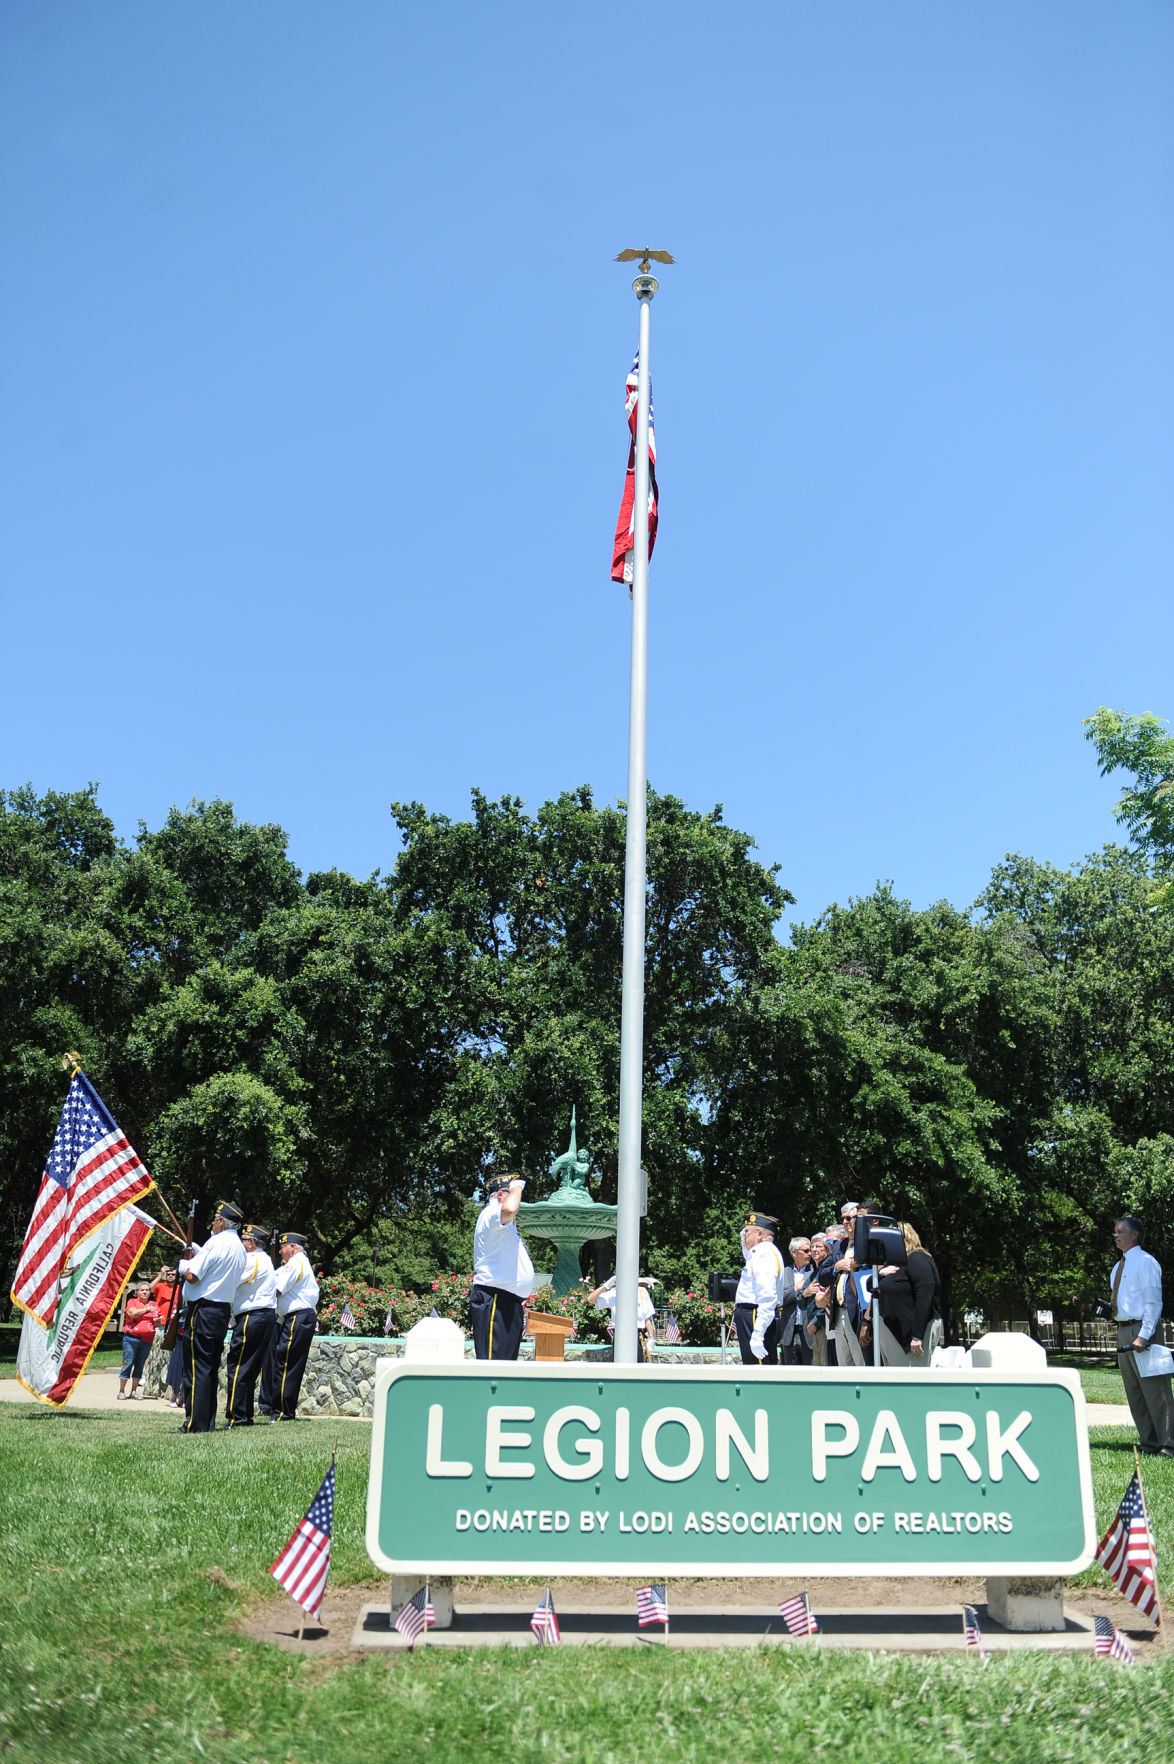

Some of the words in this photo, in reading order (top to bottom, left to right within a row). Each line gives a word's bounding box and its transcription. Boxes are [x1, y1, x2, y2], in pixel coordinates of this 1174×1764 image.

[425, 1403, 771, 1482] LEGION
[810, 1409, 1041, 1482] PARK
[455, 1508, 571, 1532] DONATED
[579, 1510, 611, 1532] BY
[618, 1510, 675, 1533] LODI
[683, 1510, 843, 1533] ASSOCIATION
[852, 1511, 886, 1533] OF
[893, 1511, 1014, 1533] REALTORS
